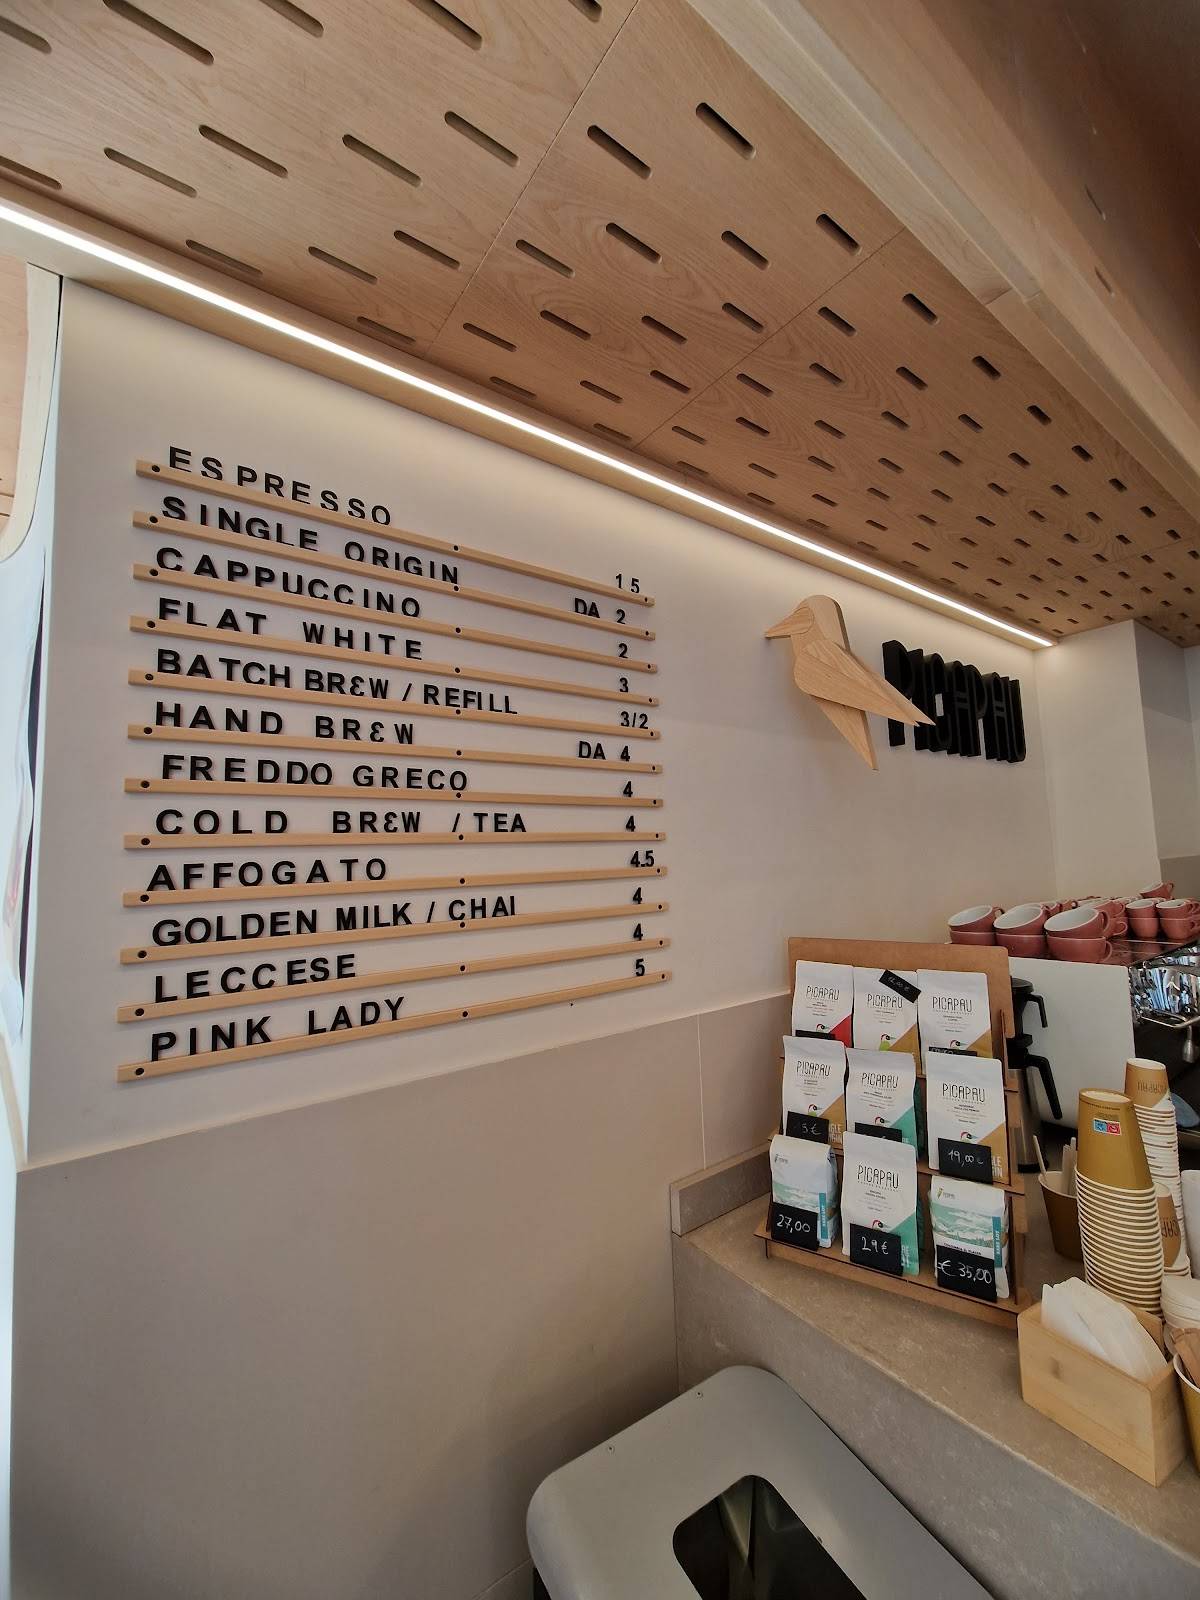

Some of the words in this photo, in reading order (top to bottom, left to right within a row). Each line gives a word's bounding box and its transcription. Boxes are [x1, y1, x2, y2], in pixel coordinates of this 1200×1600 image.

[169, 446, 391, 525] ESPRESSO
[162, 496, 318, 551] SINGLE
[344, 541, 458, 584] ORIGIN
[574, 598, 600, 618] DA
[616, 609, 625, 624] 2
[157, 547, 420, 617] CAPPUCCINO
[618, 643, 628, 658] 2
[158, 598, 266, 634] FLAT
[303, 622, 422, 660] WHITE
[619, 678, 629, 692] 3
[157, 649, 290, 688] BATCH
[402, 683, 412, 701] /
[424, 684, 517, 714] REFILL
[620, 711, 648, 729] 3/2
[156, 702, 283, 734] HAND
[578, 741, 606, 760] DA
[620, 745, 630, 762] 4
[162, 754, 332, 785] FREDDO
[353, 765, 467, 790] GRECO
[623, 781, 633, 797] 4
[156, 809, 288, 834] COLD
[452, 813, 460, 832] /
[473, 813, 526, 832] TEA
[625, 815, 635, 832] 4
[147, 858, 386, 891] AFFOGATO
[630, 850, 654, 867] 4.5
[152, 910, 317, 946] GOLDEN
[336, 903, 412, 931] MILK
[427, 902, 435, 923] /
[448, 896, 515, 921] CHAI
[633, 887, 642, 904] 4
[155, 954, 356, 1003] LECCESE
[633, 923, 643, 941] 4
[151, 1016, 271, 1061] PINK
[308, 997, 404, 1035] LADY
[635, 958, 645, 976] 5
[806, 985, 840, 1000] PICAPAU
[867, 993, 903, 1008] PICAPAU
[932, 996, 973, 1012] PICAPAU
[797, 1060, 831, 1076] PICAPAU
[861, 1072, 899, 1088] PICAPAU
[942, 1083, 986, 1102] PICAPAU
[857, 1164, 899, 1189] PICAPAU
[776, 1214, 811, 1234] 27,00
[958, 1262, 993, 1285] 35,00
